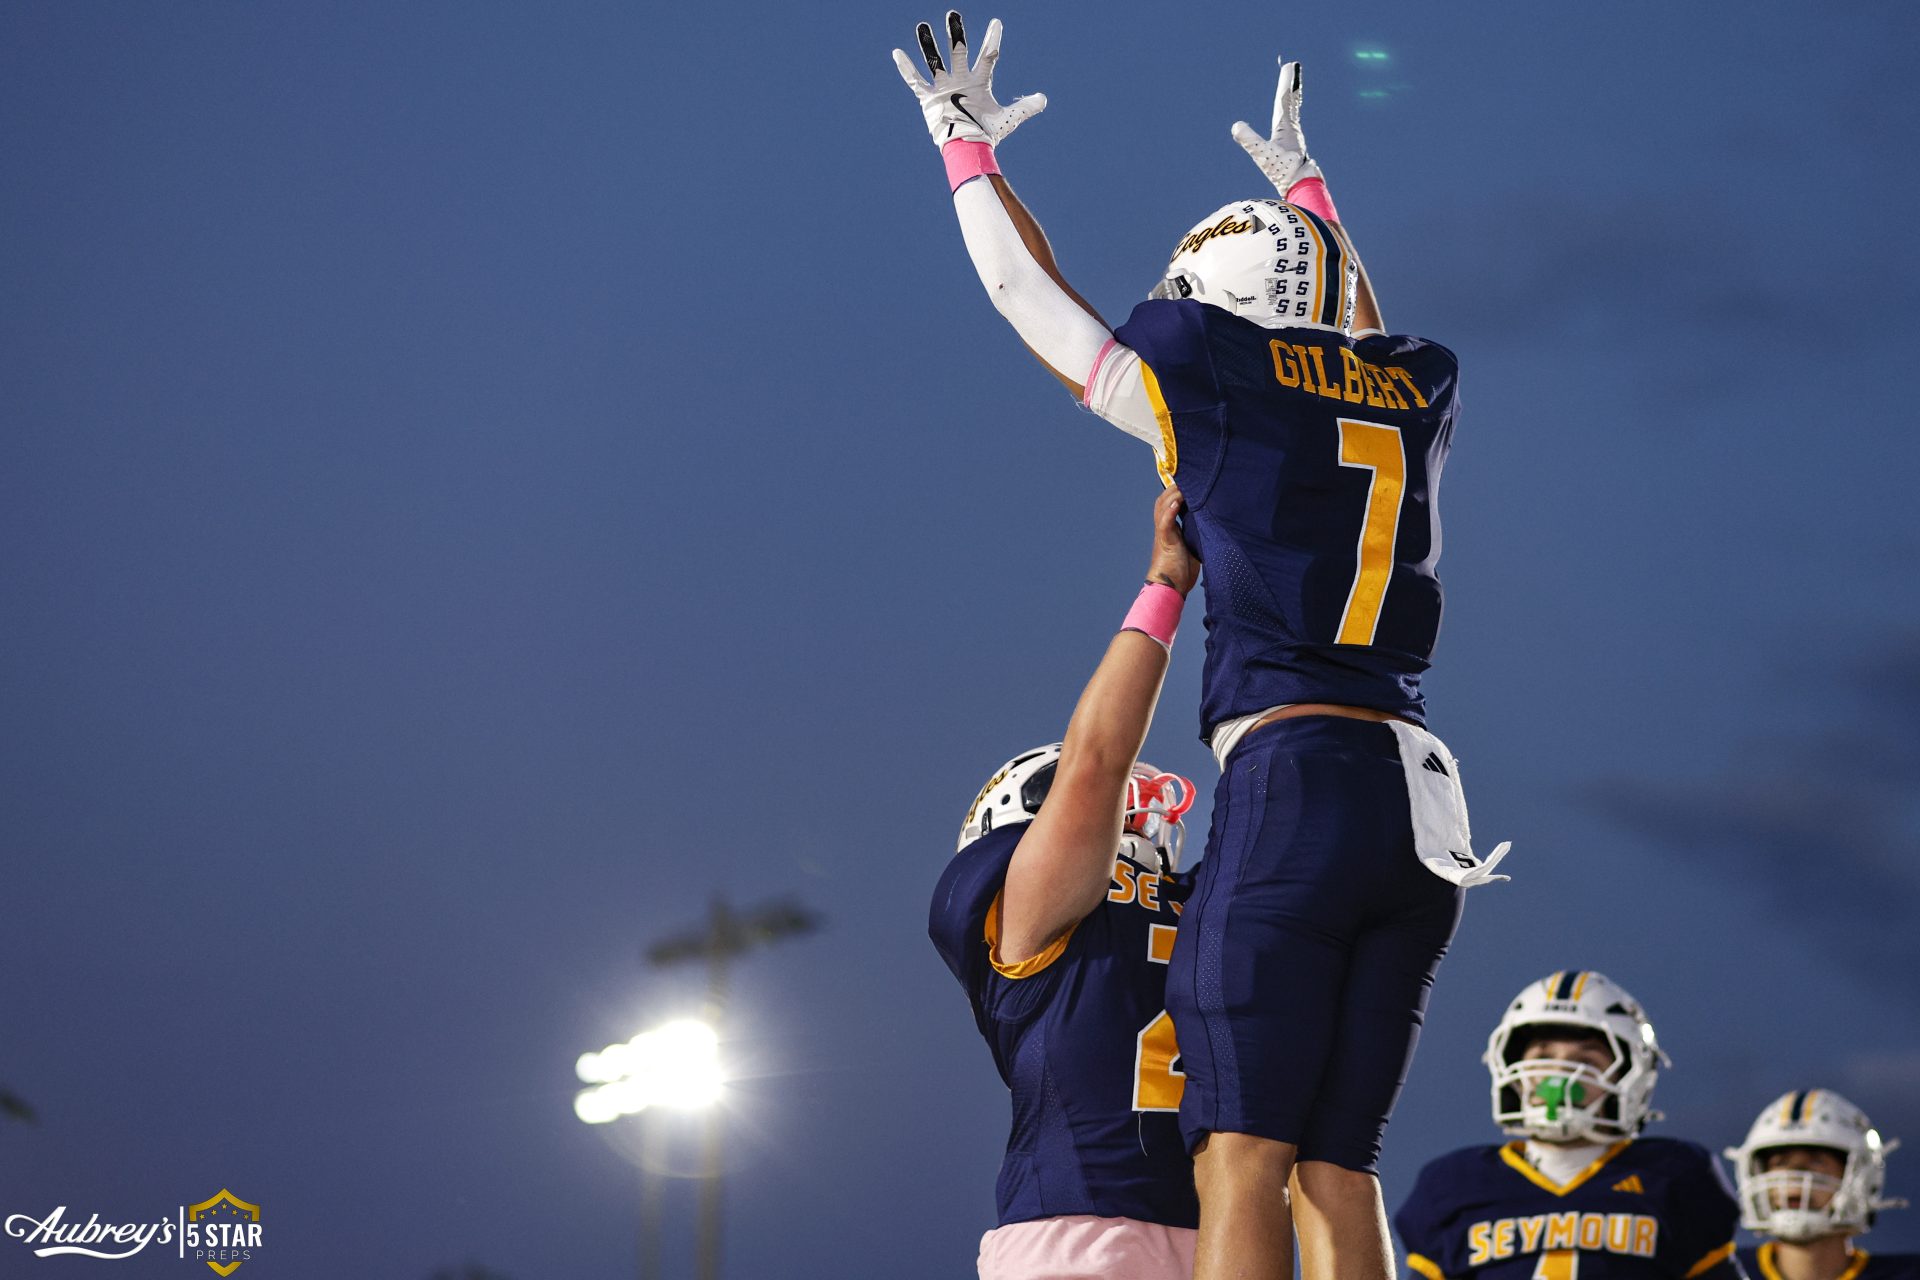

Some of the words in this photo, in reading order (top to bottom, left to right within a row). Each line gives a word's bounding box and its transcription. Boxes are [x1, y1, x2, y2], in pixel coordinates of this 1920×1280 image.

[1286, 214, 1299, 224] S
[1267, 223, 1281, 236] S
[1294, 226, 1305, 239] S
[1276, 237, 1288, 252] S
[1297, 241, 1310, 256] S
[1274, 258, 1289, 274] S
[1295, 260, 1309, 275] S
[1275, 278, 1288, 295] S
[1295, 280, 1310, 296] S
[1275, 298, 1291, 314] S
[1294, 301, 1308, 317] S
[1268, 338, 1430, 410] GILBERT
[1333, 416, 1408, 647] 7
[1468, 1211, 1658, 1266] SEYMOUR
